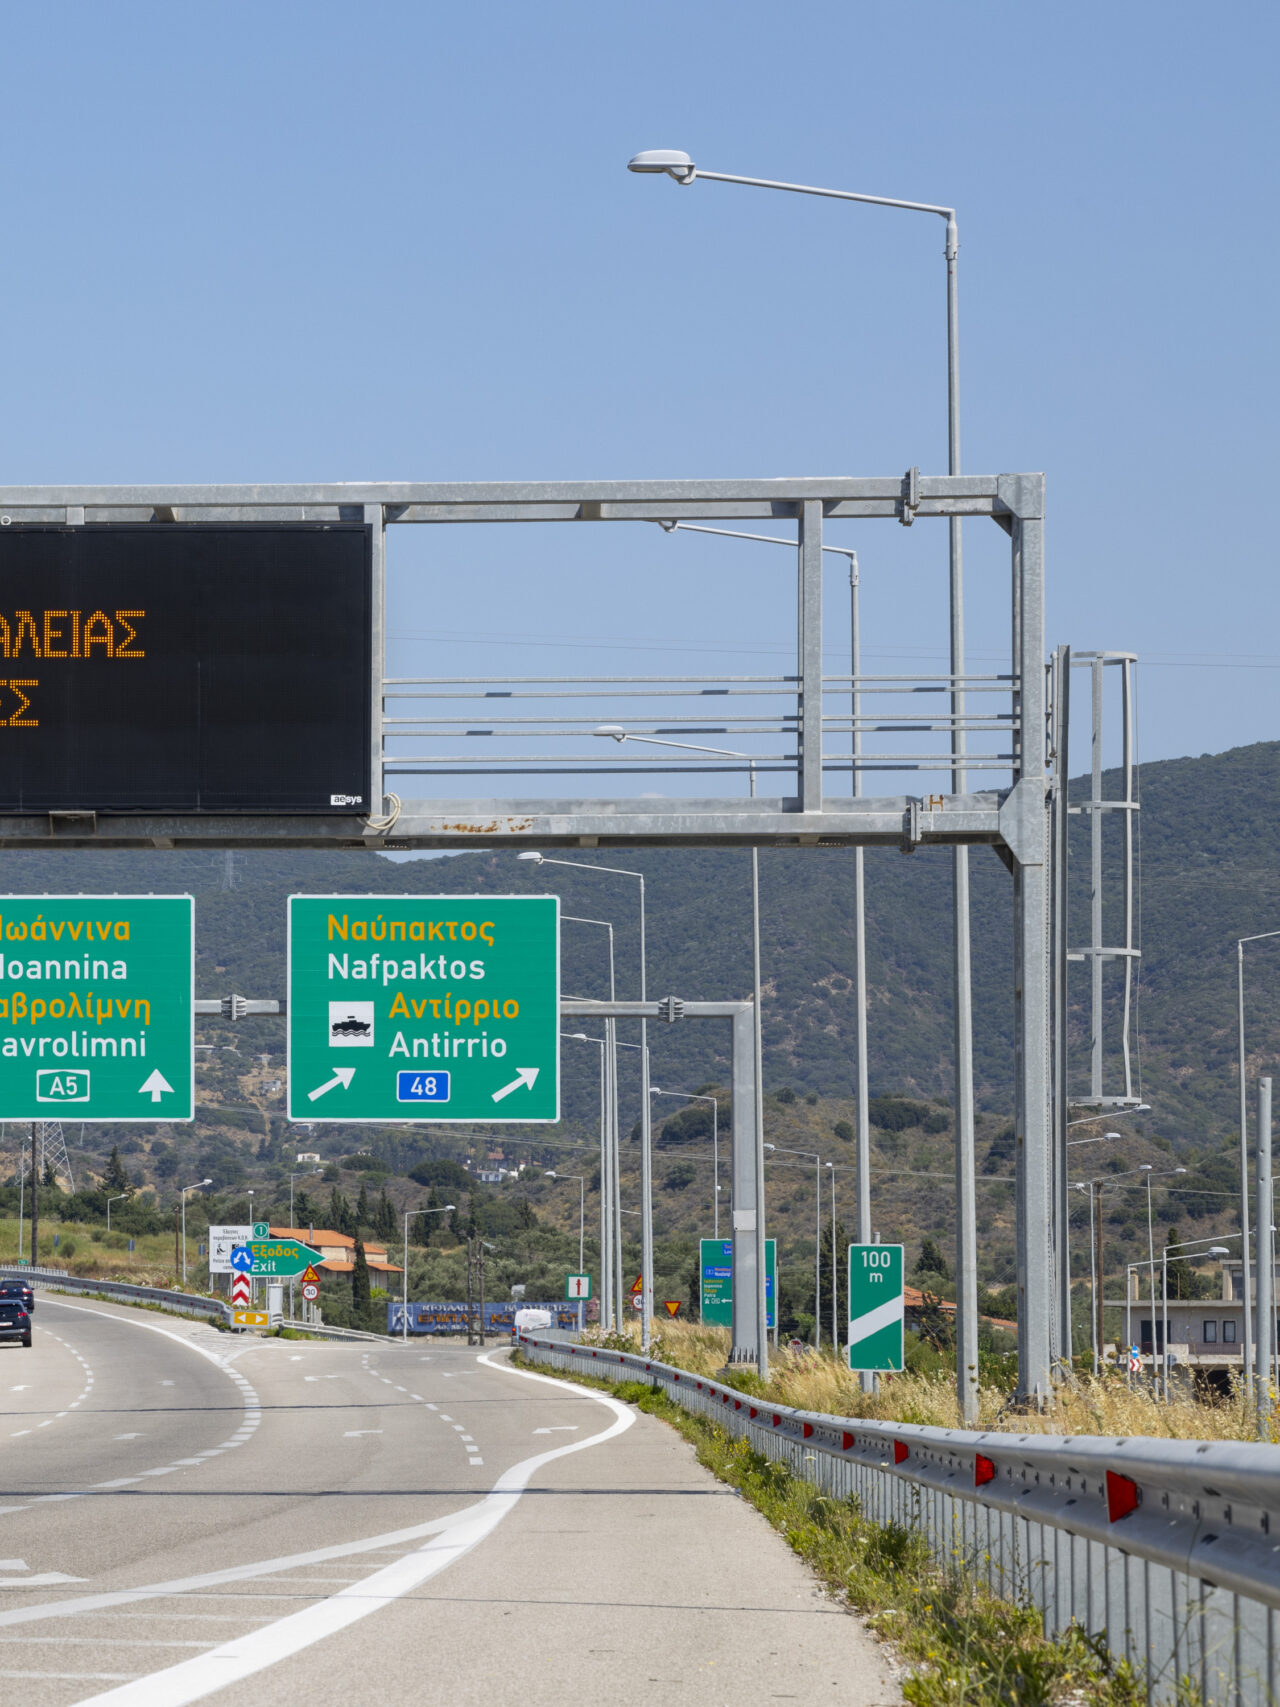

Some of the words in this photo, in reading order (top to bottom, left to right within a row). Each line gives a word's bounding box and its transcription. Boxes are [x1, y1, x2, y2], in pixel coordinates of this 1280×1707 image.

[327, 914, 496, 947] Ναύπακτος
[328, 953, 485, 987] Nafpaktos
[388, 991, 520, 1026] Αντίρριο
[388, 1031, 507, 1058] Antirrio
[49, 1076, 78, 1096] A5
[410, 1076, 437, 1096] 48
[251, 1259, 276, 1272] Exit
[860, 1250, 891, 1268] 100
[869, 1272, 884, 1283] m
[305, 1287, 317, 1297] 30
